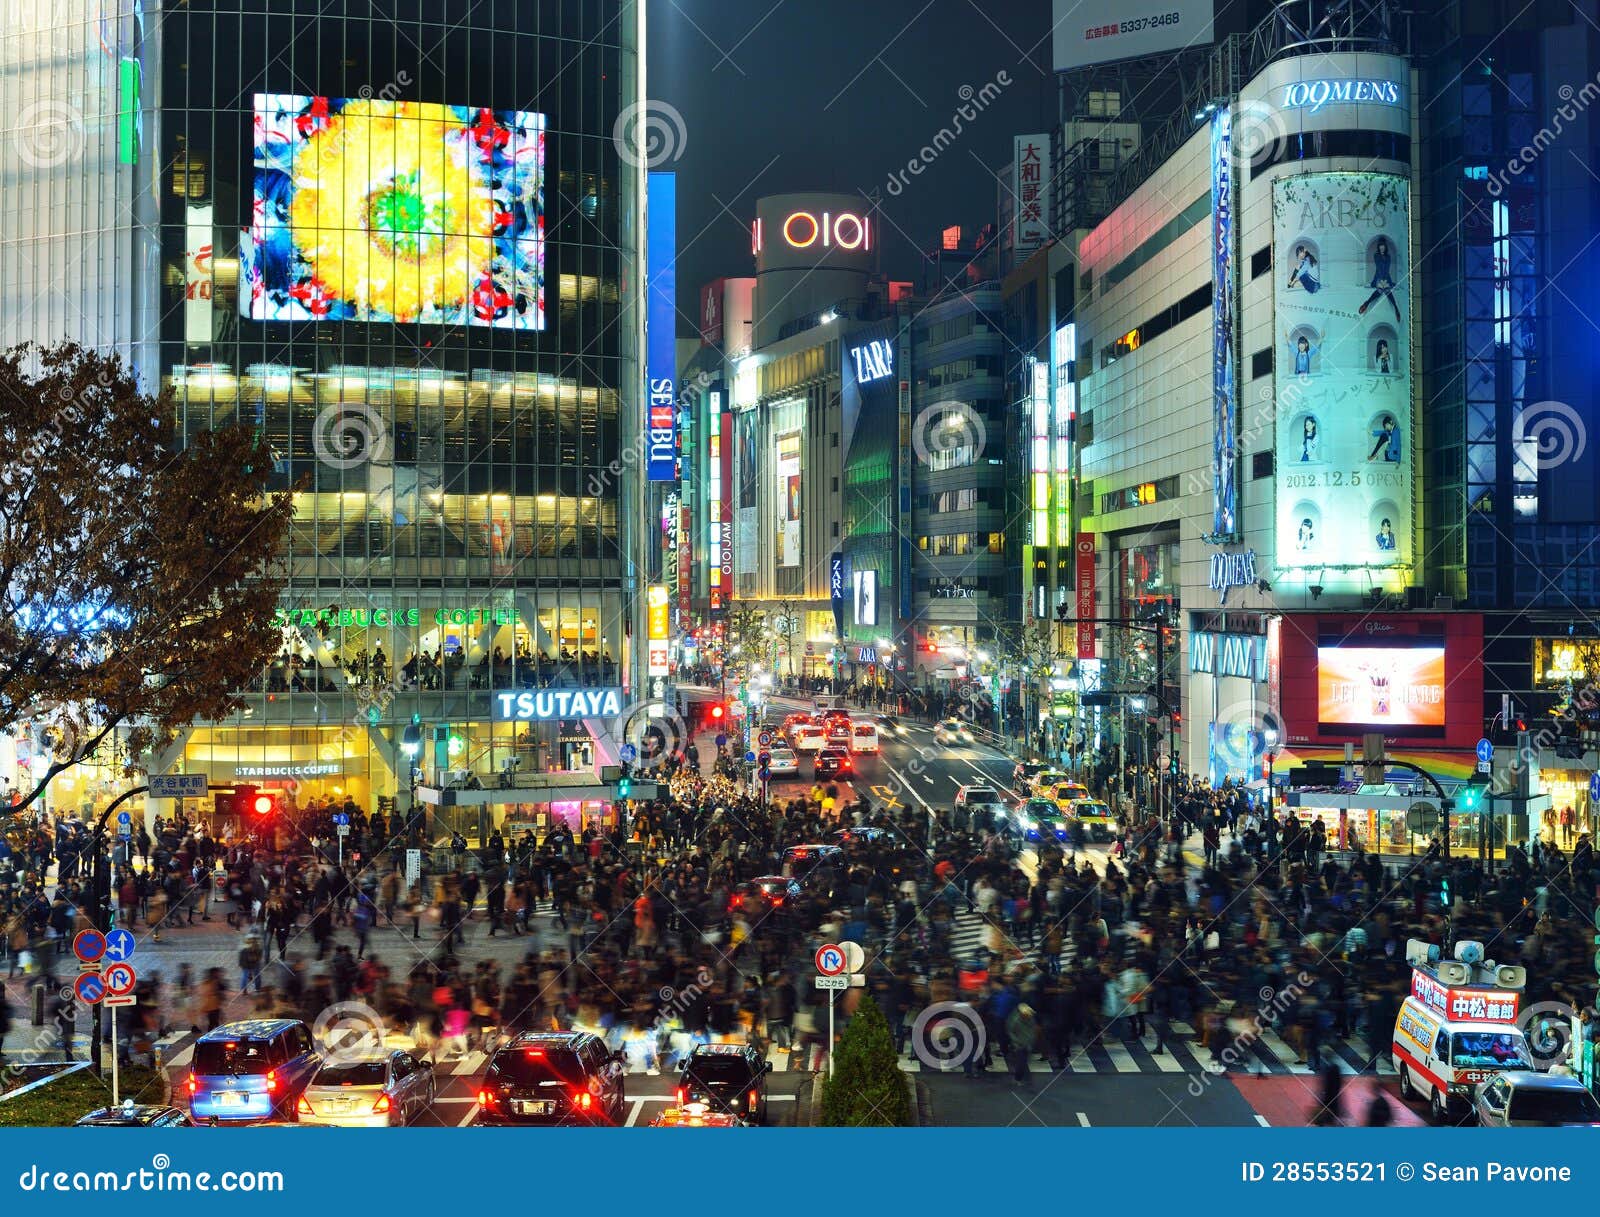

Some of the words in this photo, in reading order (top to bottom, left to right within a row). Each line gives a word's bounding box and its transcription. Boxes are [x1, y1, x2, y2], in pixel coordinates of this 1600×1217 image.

[1120, 12, 1180, 33] 5337-2468
[1021, 143, 1041, 224] 大和証券
[1299, 199, 1388, 229] AKB48
[851, 338, 893, 384] ZARA
[650, 378, 673, 462] SEIBU
[1286, 471, 1361, 488] 2012.12.5
[831, 559, 842, 599] ZARA
[268, 608, 419, 627] STARBUCKS
[435, 608, 521, 626] COFFEE
[858, 647, 876, 662] ZARA
[498, 691, 620, 718] TSUTAYA
[235, 764, 301, 776] STARBUCKS
[303, 764, 339, 775] COFFEE
[153, 776, 204, 788] 渋谷駅前
[817, 979, 845, 987] ここから
[1452, 996, 1514, 1019] 中松義郎
